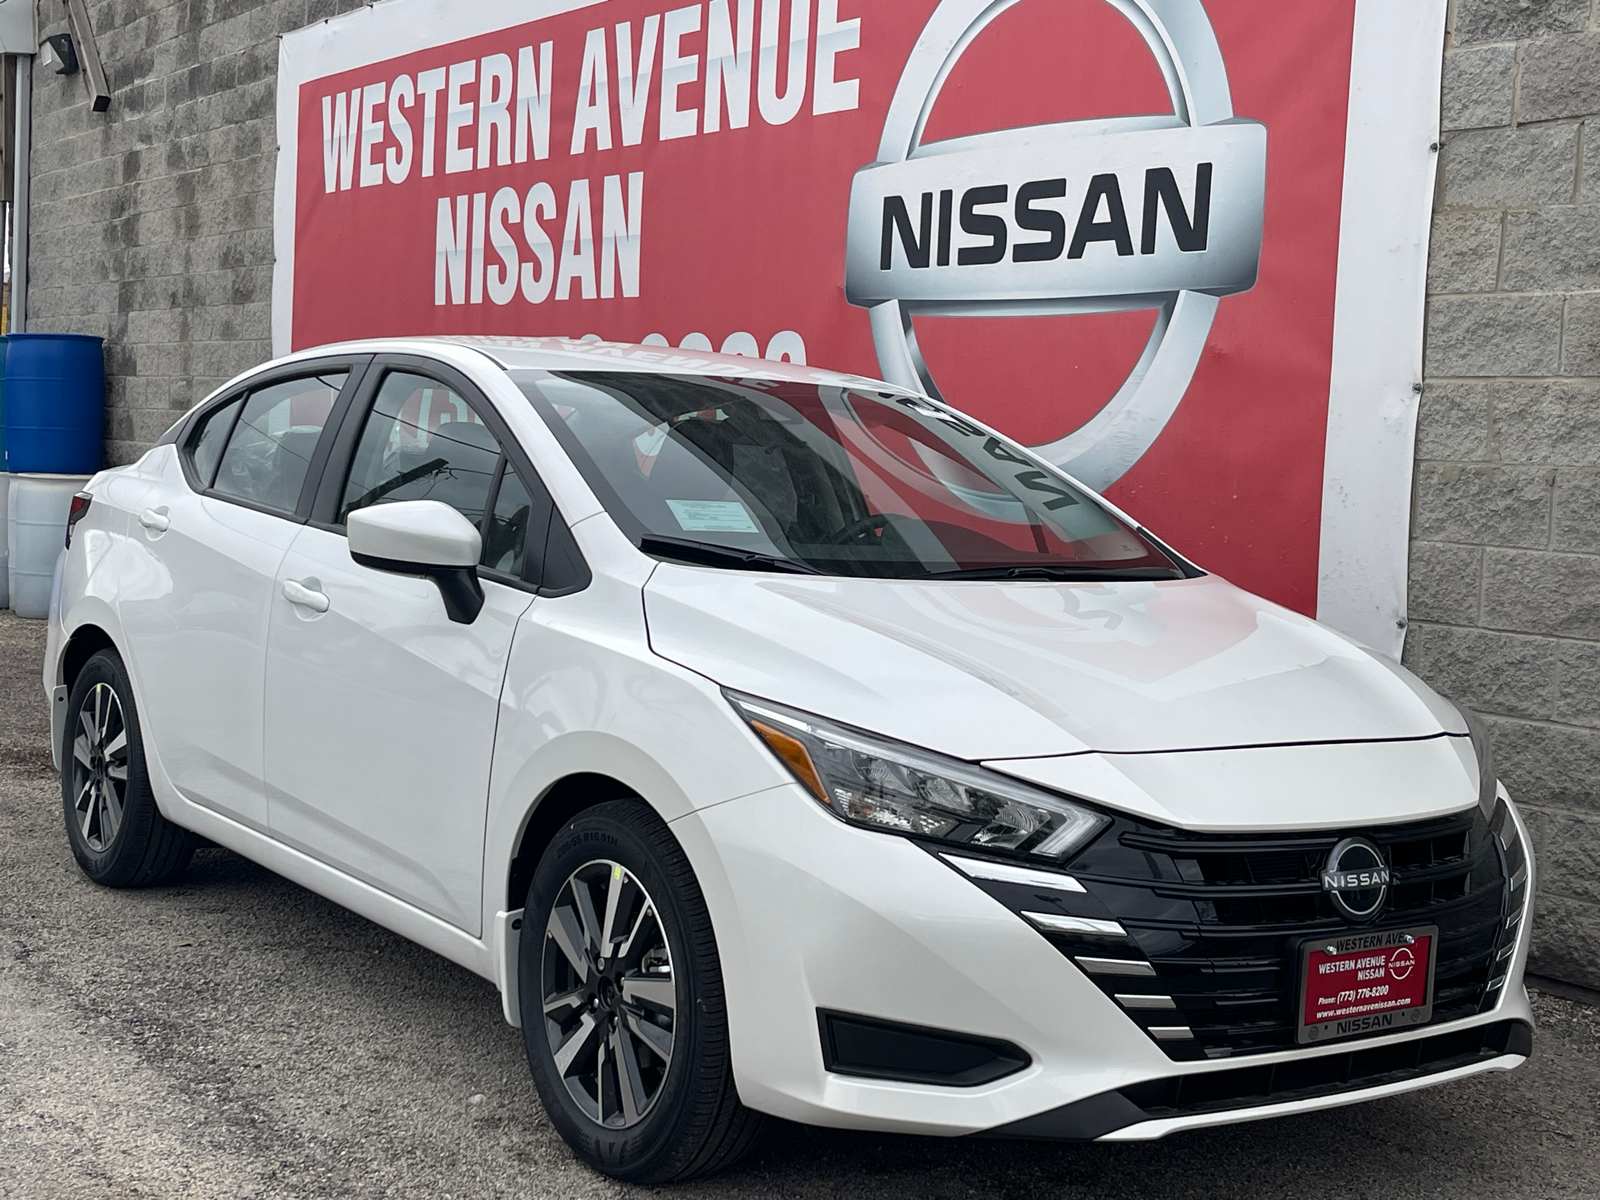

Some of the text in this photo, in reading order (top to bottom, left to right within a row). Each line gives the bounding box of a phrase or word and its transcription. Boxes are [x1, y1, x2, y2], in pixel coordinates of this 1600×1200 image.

[322, 0, 861, 194] WESTERN AVENUE
[880, 162, 1213, 270] NISSAN
[434, 171, 644, 306] NISSAN
[1324, 870, 1390, 888] NISSAN
[1336, 934, 1384, 952] WESTERN
[1318, 955, 1386, 974] WESTERN AVENUE
[1357, 967, 1385, 981] NISSAN
[1388, 960, 1415, 968] NISSAN
[1318, 985, 1389, 1005] Phone: (773) 776-8200
[1316, 998, 1411, 1019] www.westernavenissan.com
[1337, 1013, 1392, 1034] NISSAN
